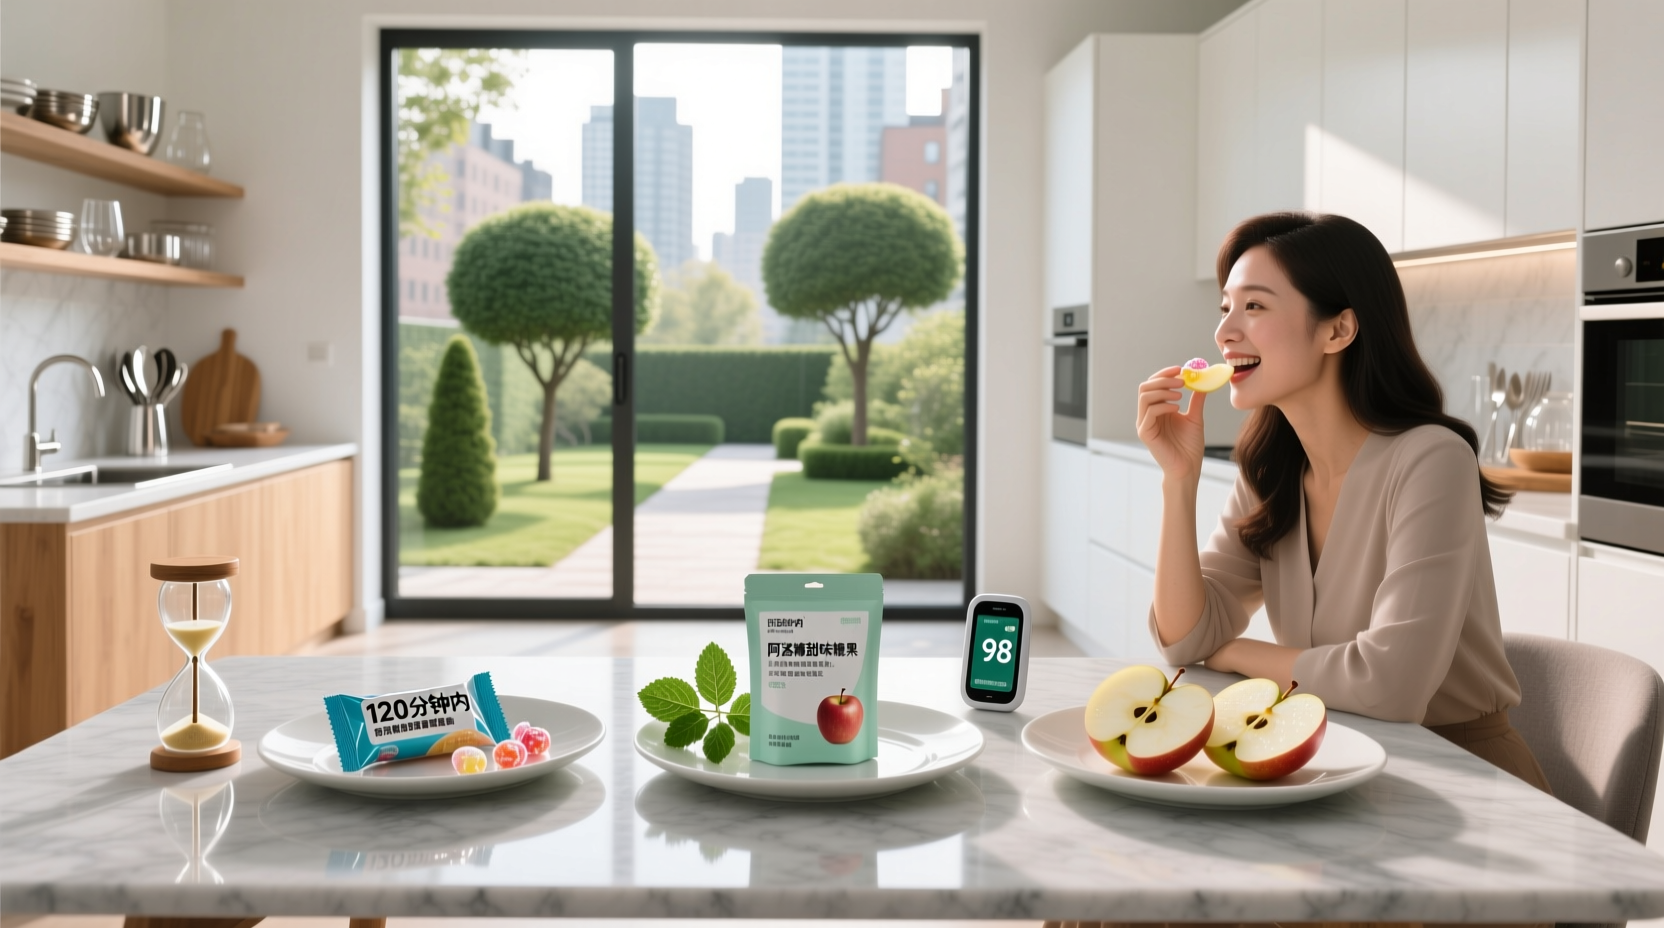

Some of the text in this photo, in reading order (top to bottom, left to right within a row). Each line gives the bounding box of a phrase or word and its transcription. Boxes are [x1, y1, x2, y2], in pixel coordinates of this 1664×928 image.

[982, 638, 1012, 664] 98
[366, 691, 470, 724] 120分钟内
